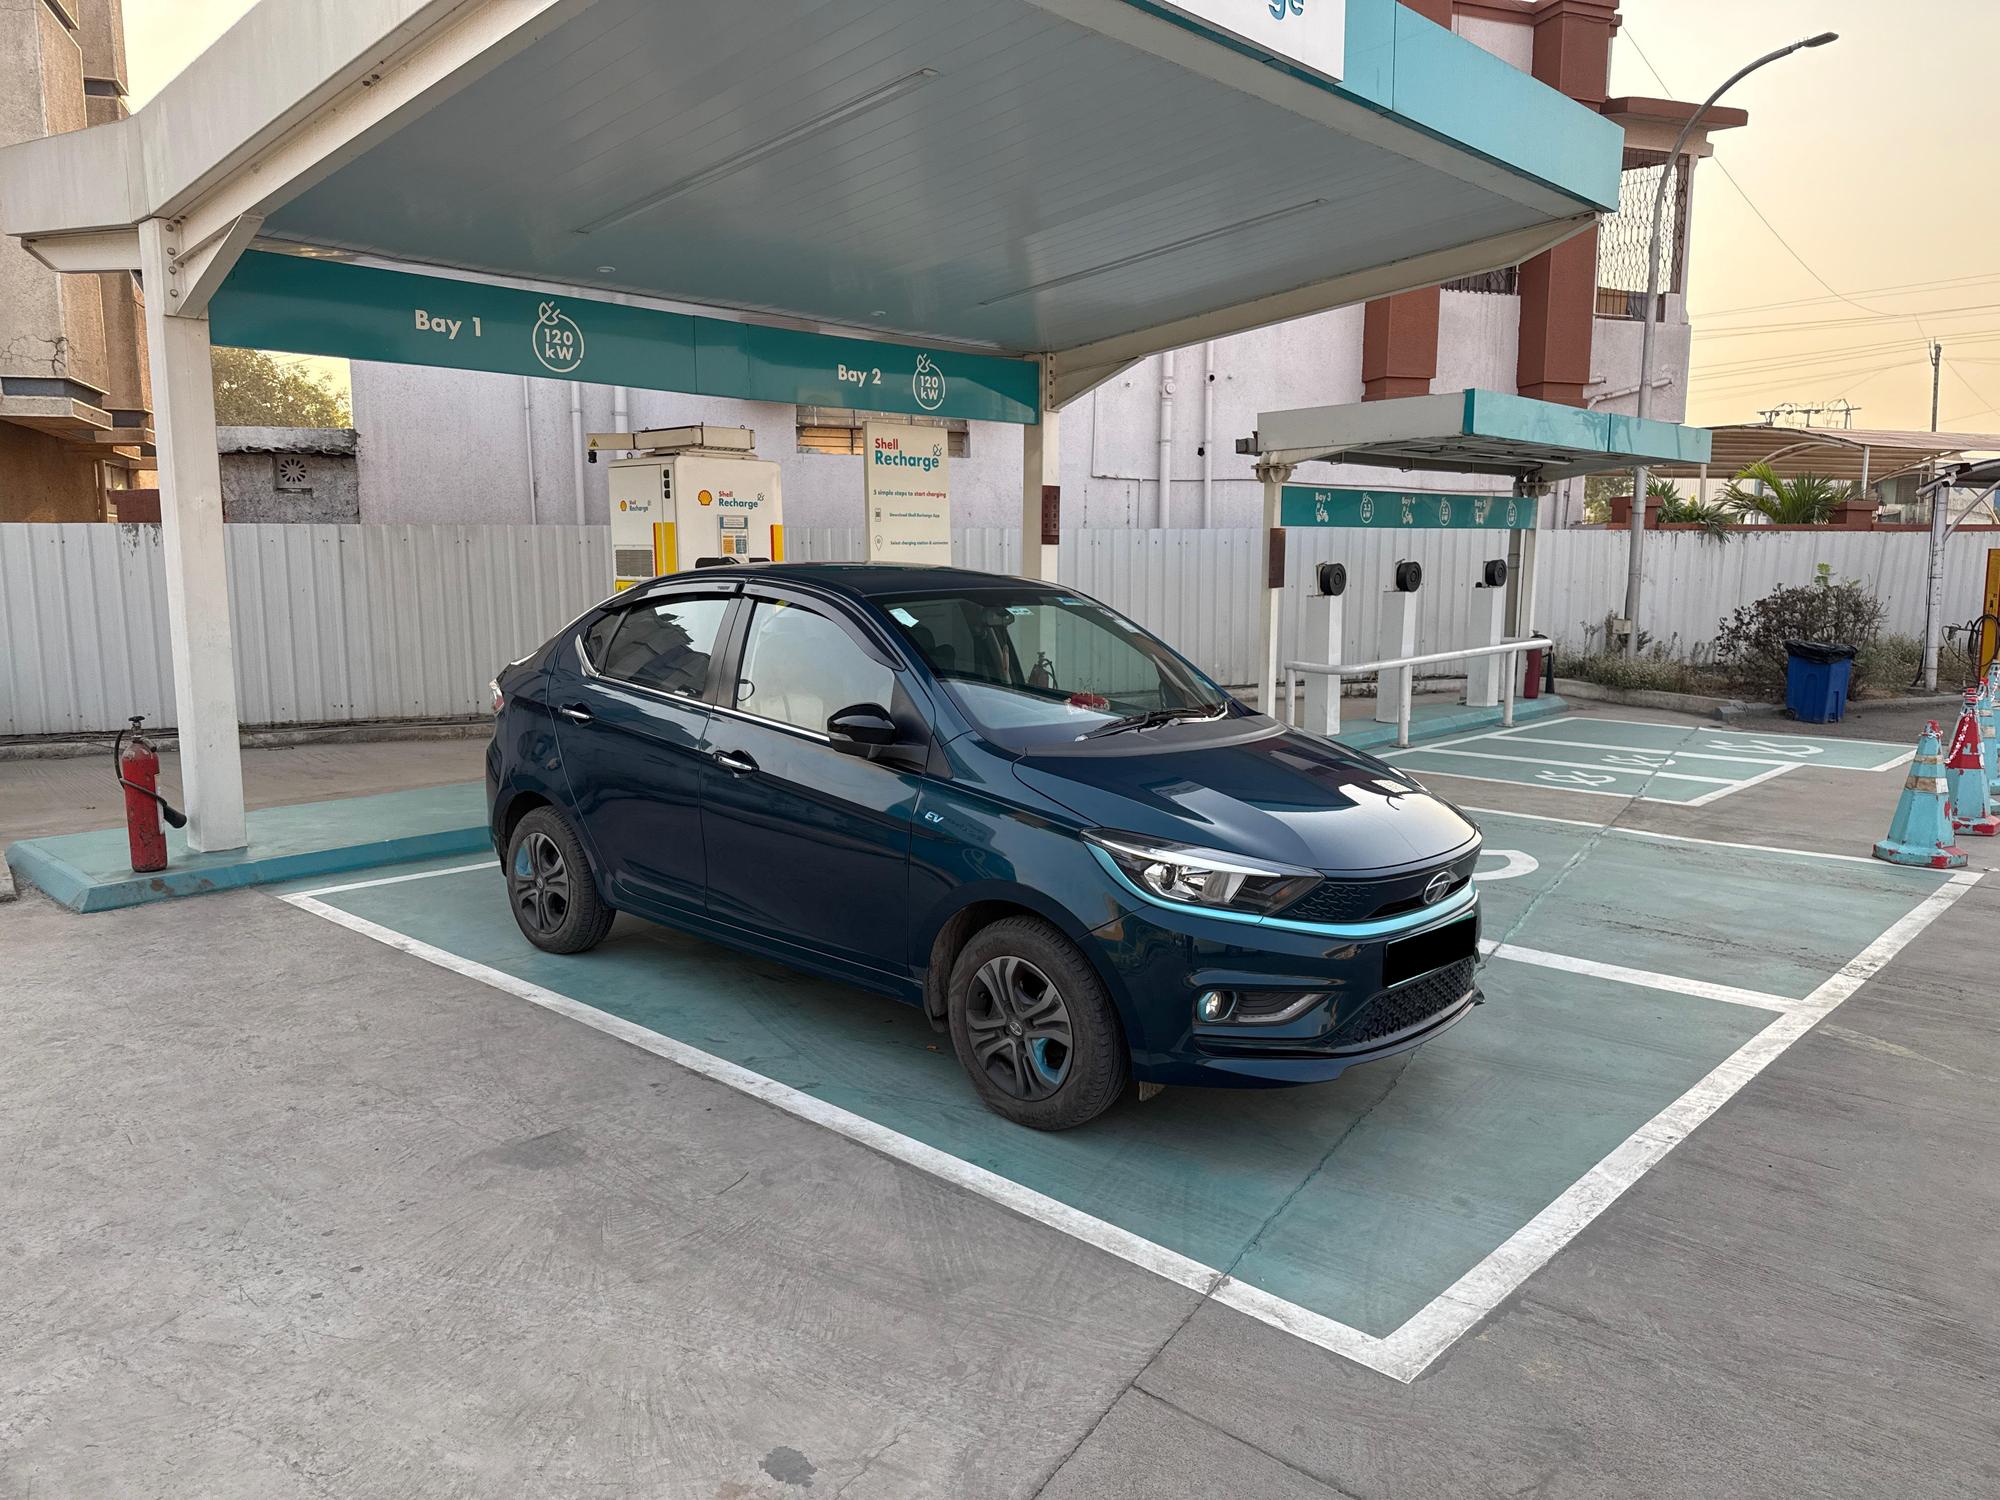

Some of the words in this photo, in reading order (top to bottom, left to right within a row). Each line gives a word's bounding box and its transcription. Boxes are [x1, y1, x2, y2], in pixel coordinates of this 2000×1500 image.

[414, 309, 462, 340] Bay
[472, 316, 482, 337] 1
[544, 328, 574, 346] 120
[545, 343, 574, 361] kW
[837, 363, 867, 388] Bay
[872, 367, 882, 385] 2
[919, 375, 939, 388] 120
[920, 387, 939, 400] kW
[875, 437, 899, 450] Shell
[874, 449, 940, 472] Recharge
[718, 490, 734, 498] Shell
[878, 489, 894, 497] simple
[894, 490, 907, 498] steps
[926, 491, 947, 499] charging
[1315, 491, 1327, 503] Bay
[1327, 492, 1332, 501] 3
[718, 497, 759, 510] Recharge
[1401, 496, 1411, 507] Bay
[924, 811, 945, 823] EV
